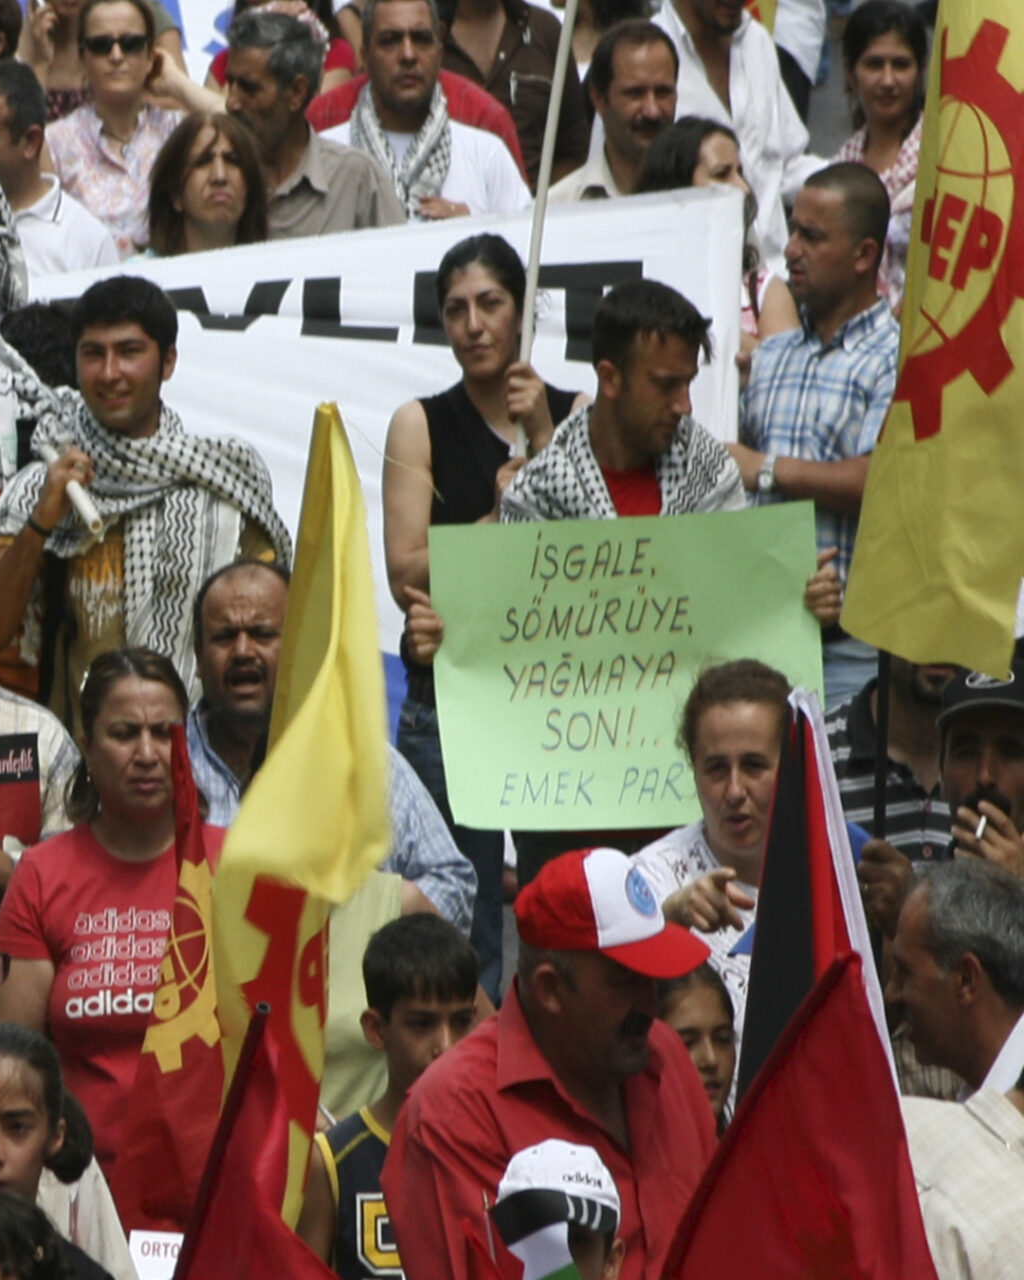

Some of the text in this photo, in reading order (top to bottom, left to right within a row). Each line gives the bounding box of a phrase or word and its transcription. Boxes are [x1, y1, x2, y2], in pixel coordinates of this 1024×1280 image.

[499, 585, 693, 644] SÖMÜRÜYE,
[503, 650, 677, 702] YAĞMAYA
[499, 762, 696, 807] EMEK PAR
[73, 906, 171, 936] adidas
[65, 987, 155, 1019] adida
